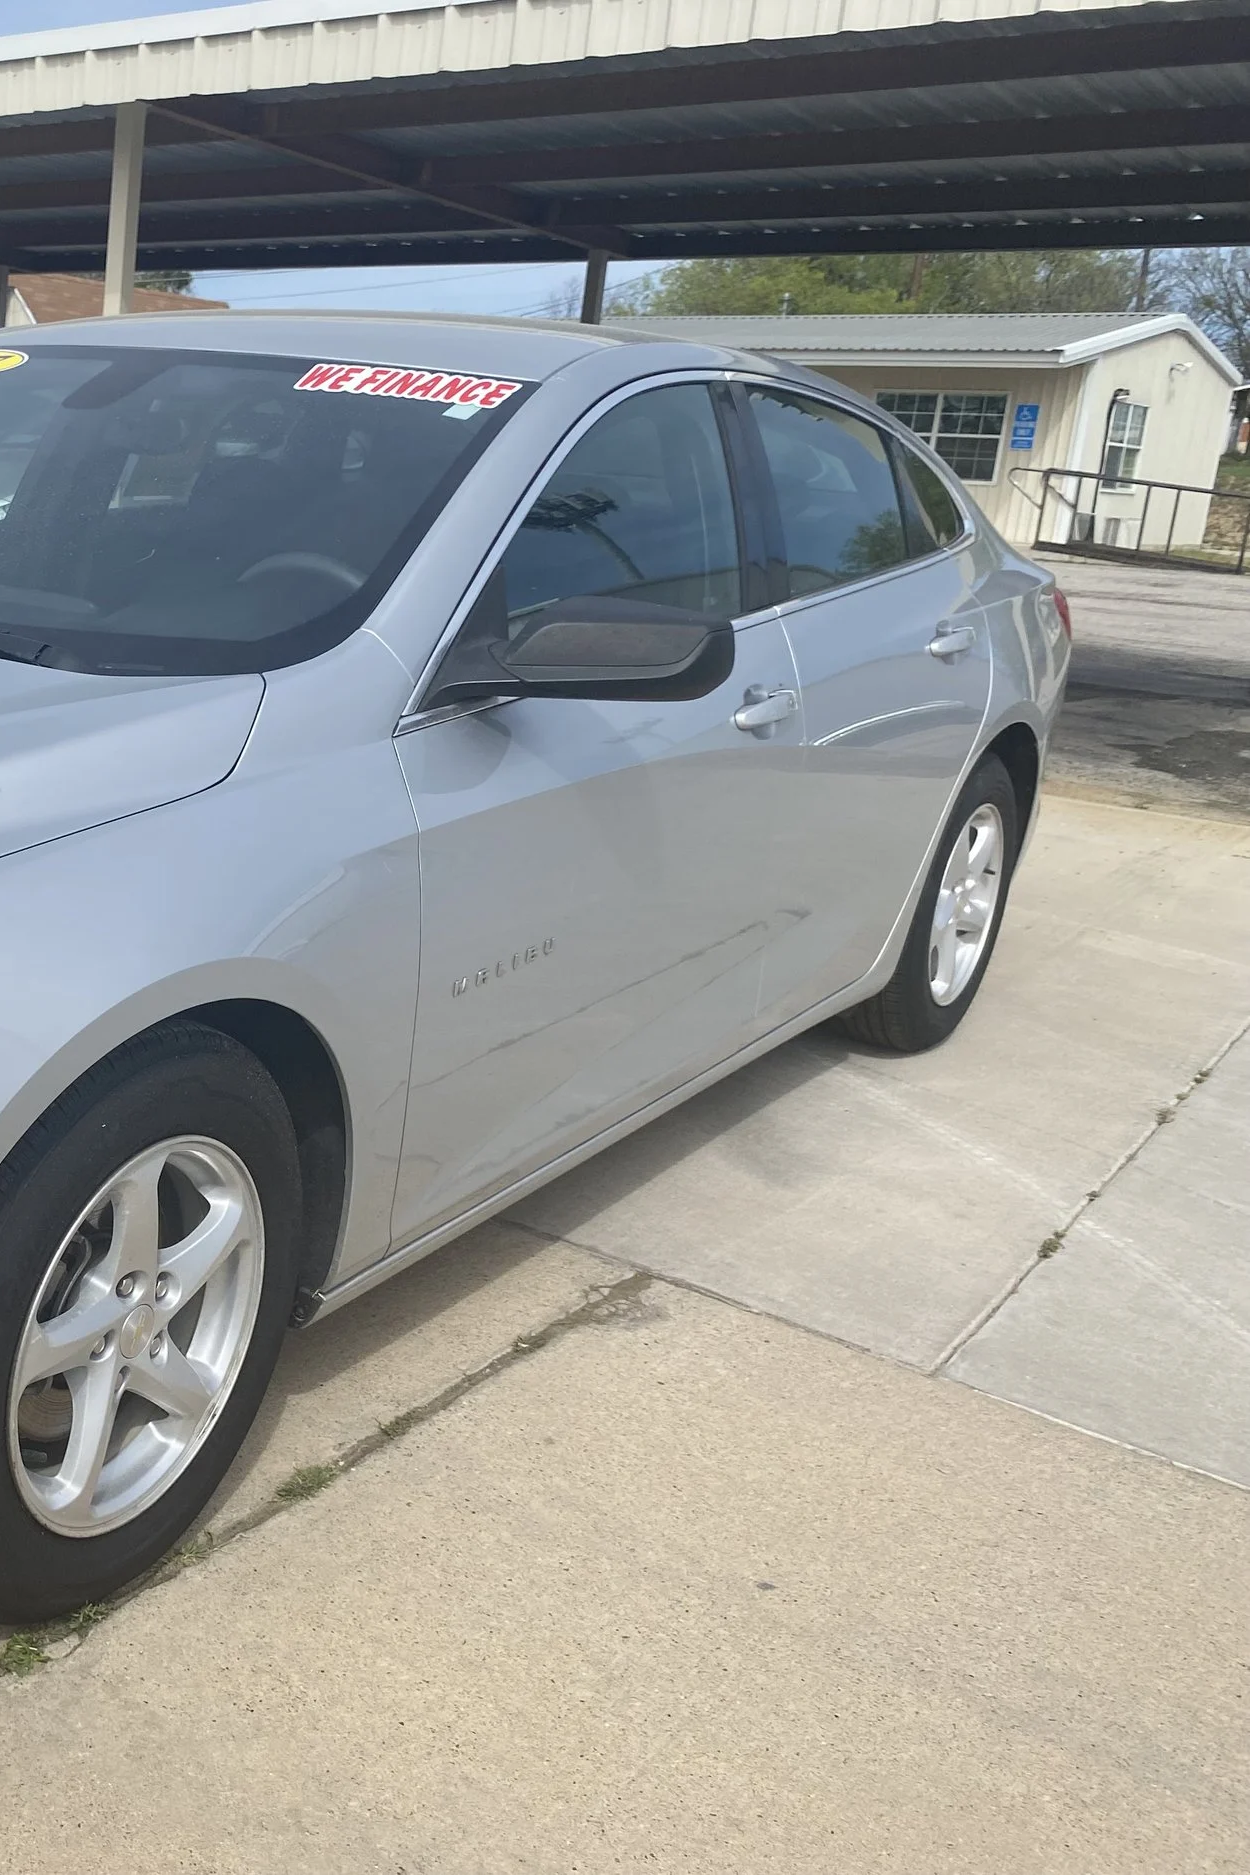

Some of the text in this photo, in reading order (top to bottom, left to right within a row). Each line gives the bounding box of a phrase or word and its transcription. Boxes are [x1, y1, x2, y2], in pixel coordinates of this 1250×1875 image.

[299, 366, 517, 405] WE FINANCE
[452, 937, 555, 998] MALIBU
